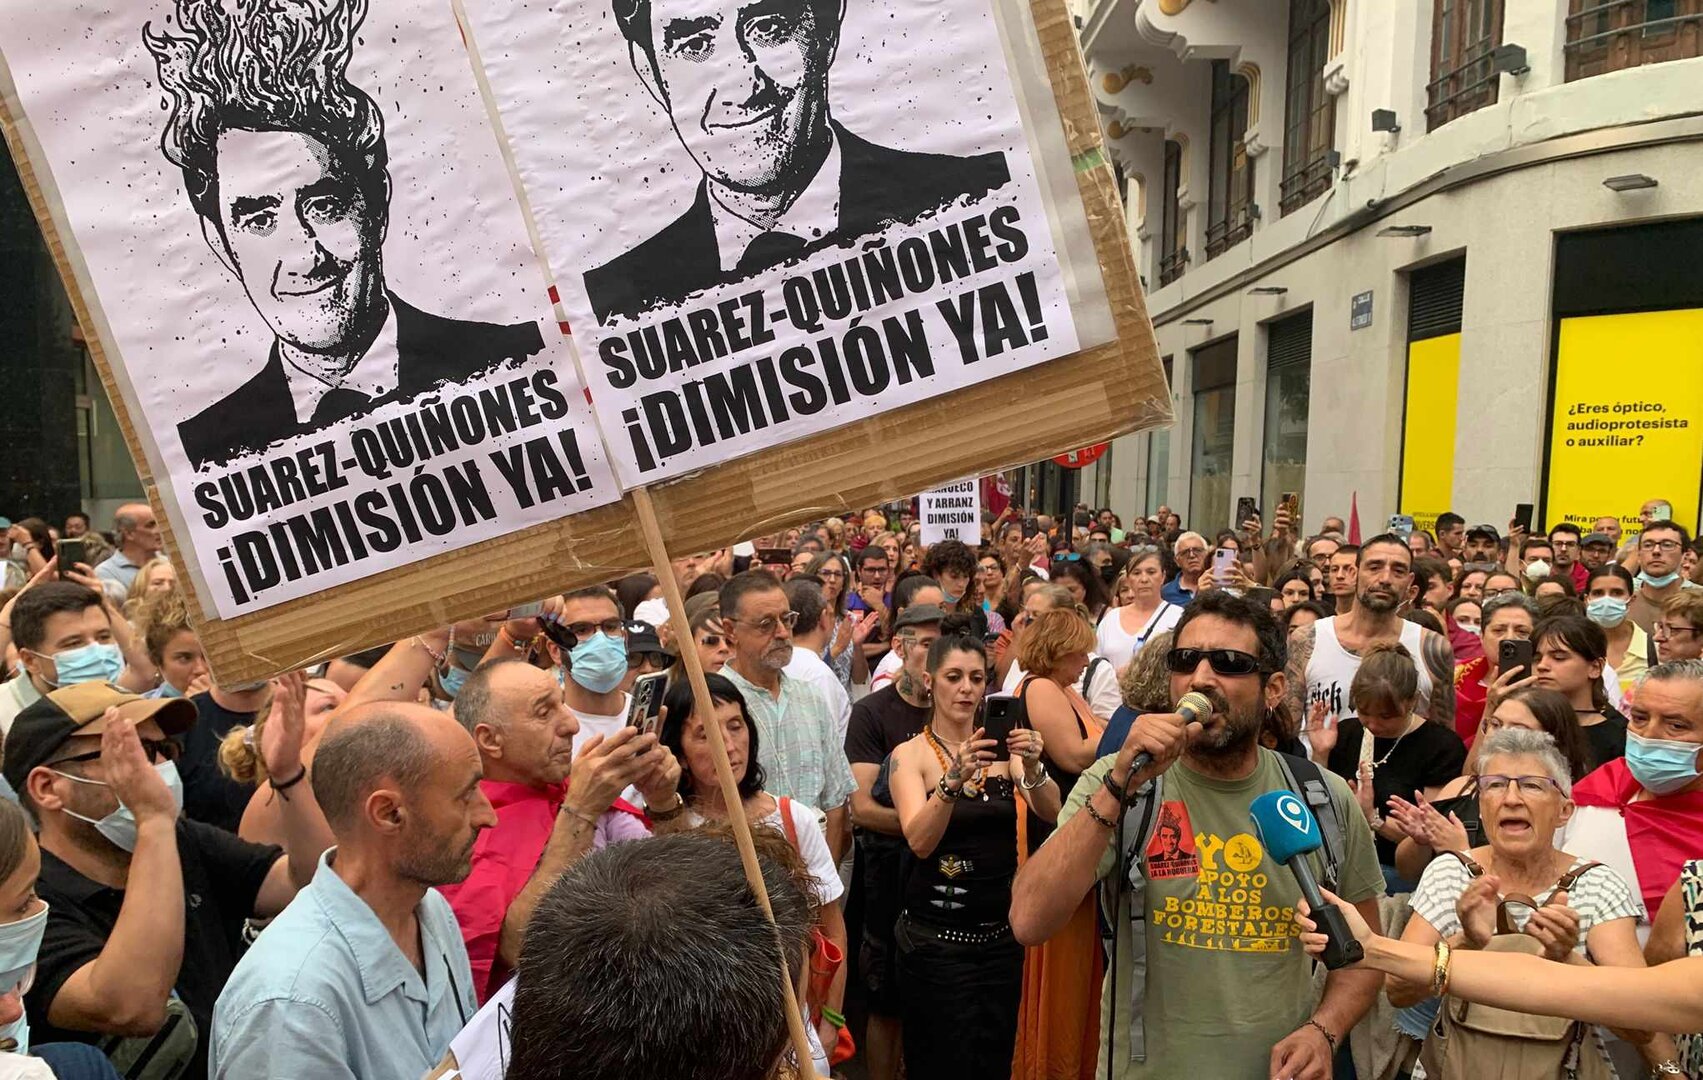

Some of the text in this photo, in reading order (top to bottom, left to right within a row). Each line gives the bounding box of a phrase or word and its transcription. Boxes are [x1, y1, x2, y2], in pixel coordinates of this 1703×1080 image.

[599, 206, 1029, 389] SUAREZ-QUIÑONES
[621, 271, 1049, 473] ¡DIMISIÓN YA!
[1568, 401, 1666, 416] ¿Eres óptico,
[1567, 418, 1688, 431] audioprotesista
[194, 369, 569, 529] SUAREZ-QUIÑONES
[1566, 435, 1644, 447] o auxiliar?
[926, 497, 974, 509] Y ARRANZ
[216, 428, 593, 606] ¡DIMISIÓN YA!
[927, 511, 974, 525] DIMISIÓN
[1564, 514, 1588, 523] Mira
[943, 528, 959, 539] YA!
[1196, 869, 1268, 888] APOYO
[1196, 884, 1262, 904] A LOS
[1165, 896, 1295, 921] BOMBEROS
[1153, 910, 1301, 937] FORESTALES
